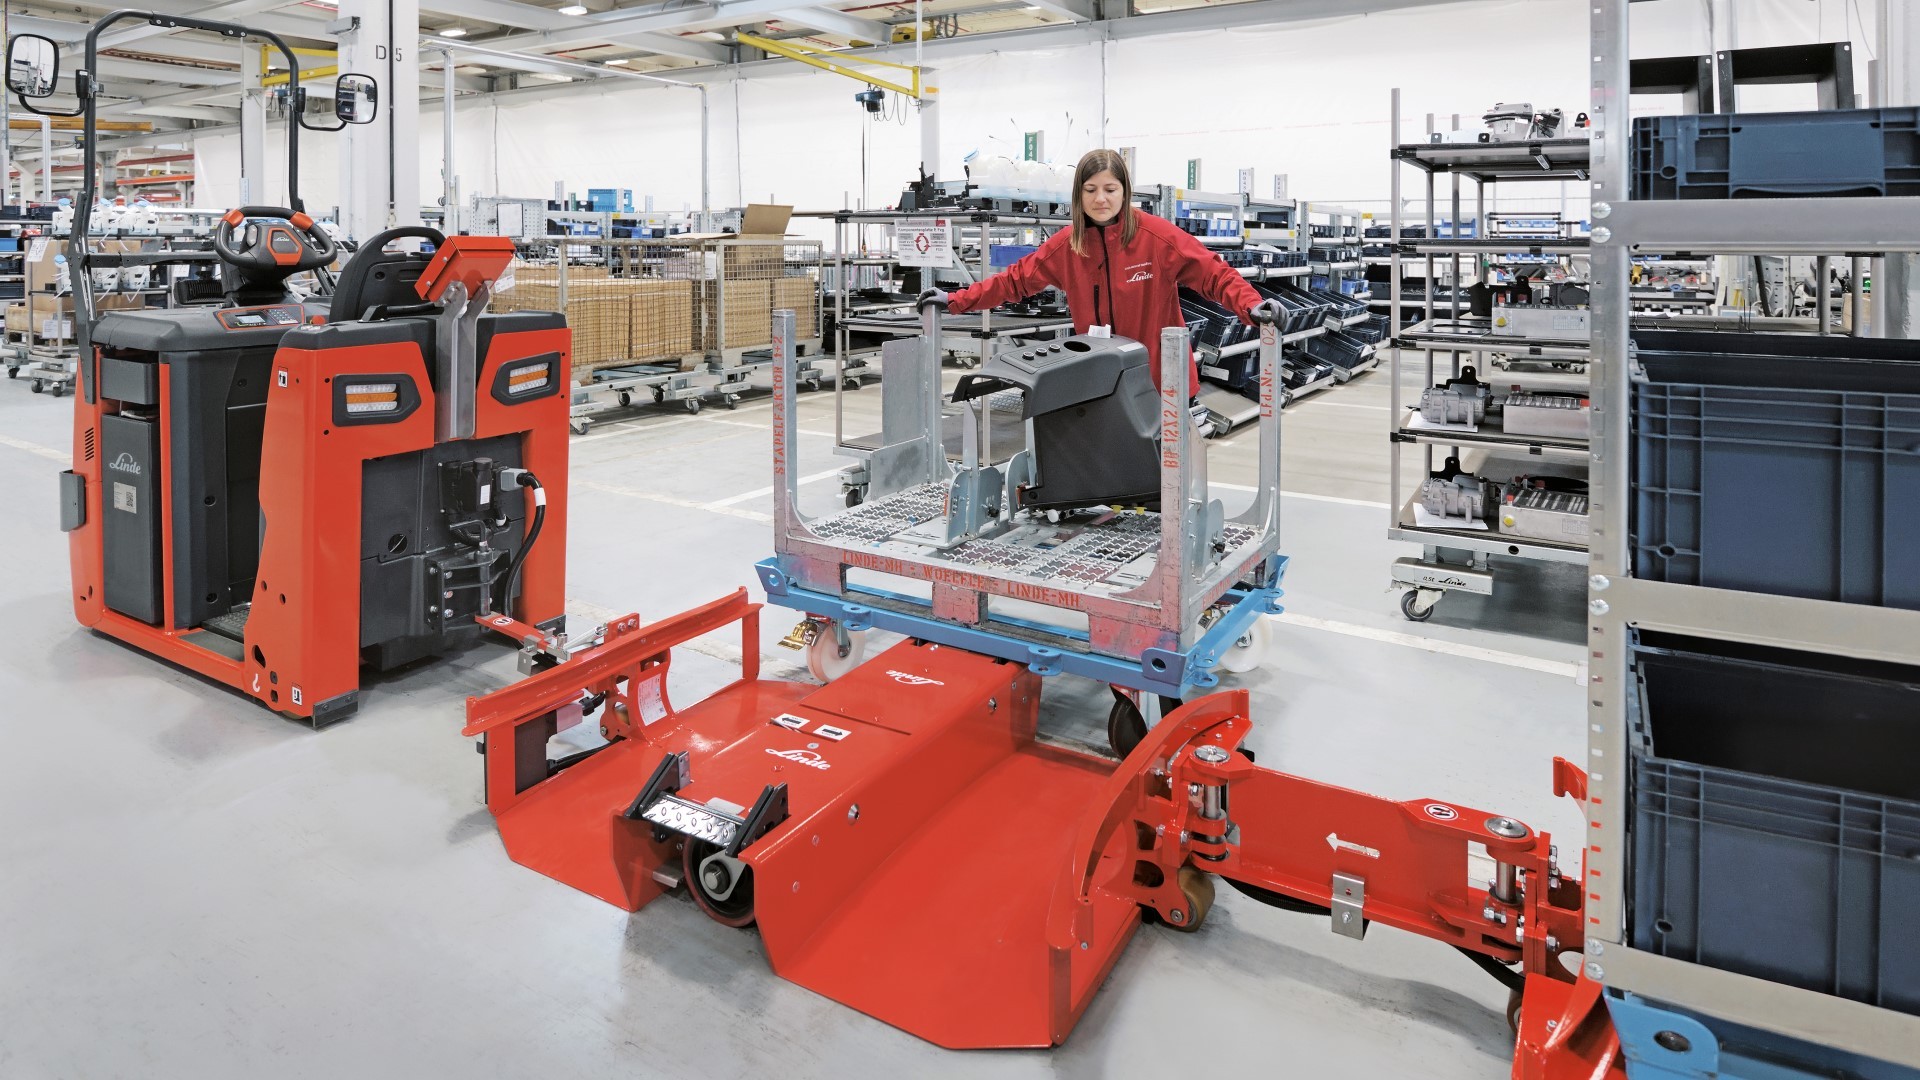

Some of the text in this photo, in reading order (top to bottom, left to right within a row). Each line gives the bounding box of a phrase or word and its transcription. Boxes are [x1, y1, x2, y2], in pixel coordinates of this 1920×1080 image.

[1126, 270, 1153, 283] Linde
[773, 336, 785, 475] STAPELFAKTOR 1+2
[109, 452, 141, 475] Linde
[842, 550, 903, 573] LINDE-MH
[1007, 581, 1080, 607] LINDE-MH
[1438, 576, 1467, 587] Linde
[885, 669, 945, 686] Linde
[765, 748, 831, 770] Linde
